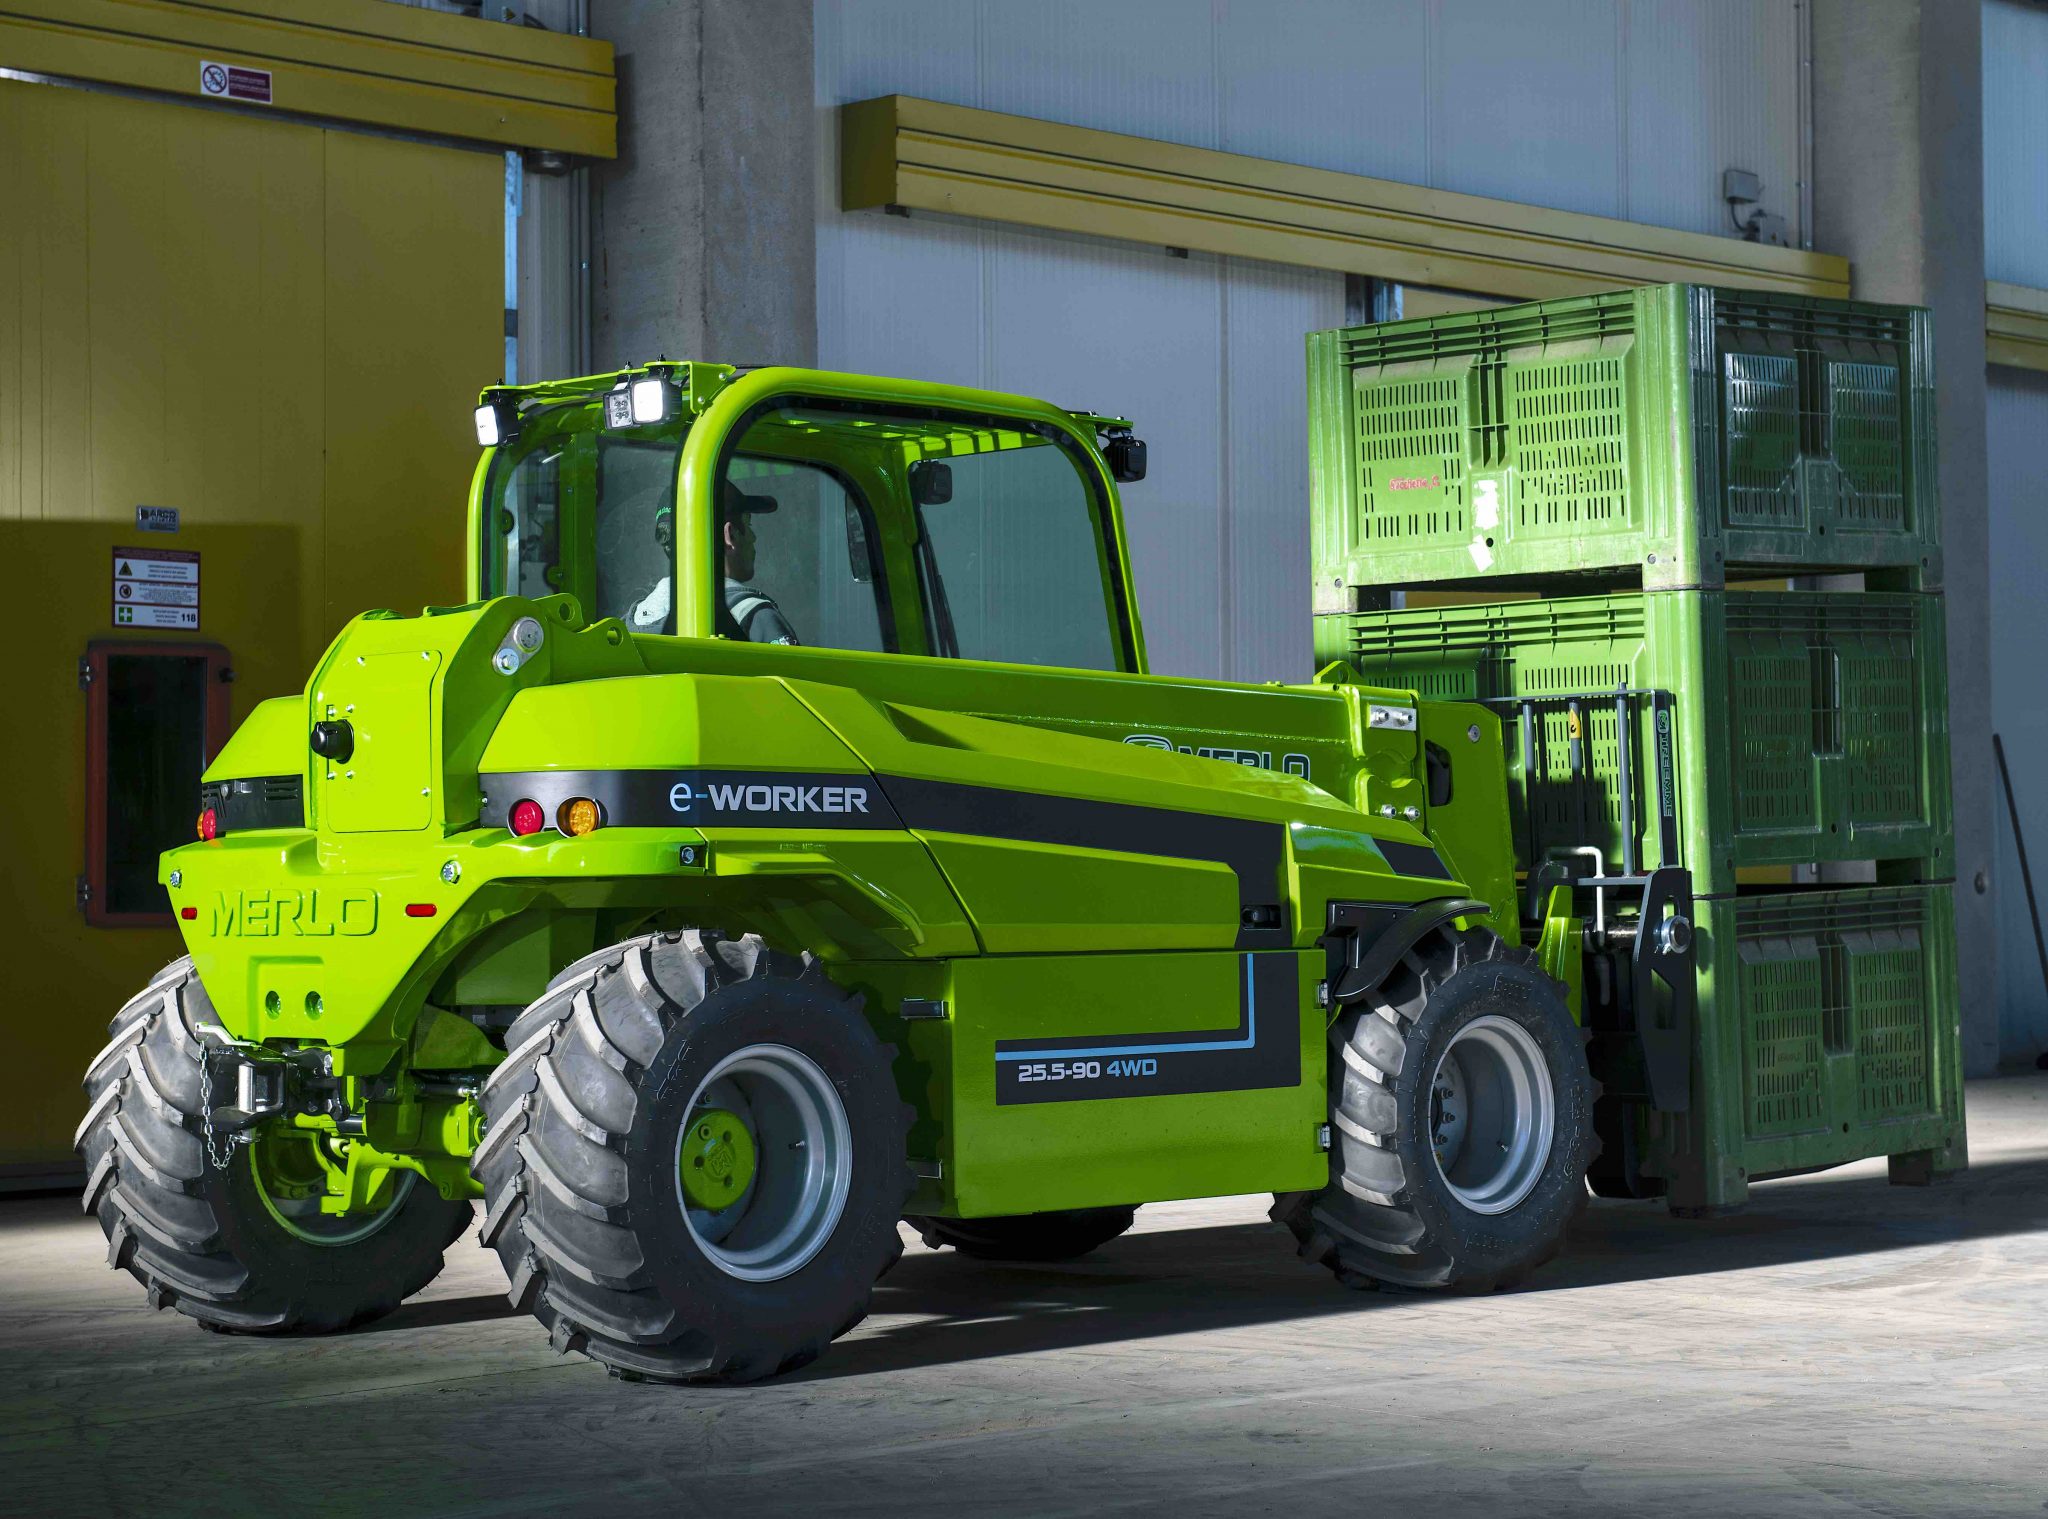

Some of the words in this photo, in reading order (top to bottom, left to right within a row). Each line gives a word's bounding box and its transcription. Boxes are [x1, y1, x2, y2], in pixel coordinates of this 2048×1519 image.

[181, 612, 197, 623] 118
[669, 781, 870, 814] e-WORKER
[210, 888, 380, 937] MERLO
[1018, 1061, 1100, 1082] 25.5-90
[1106, 1058, 1158, 1077] 4WD
